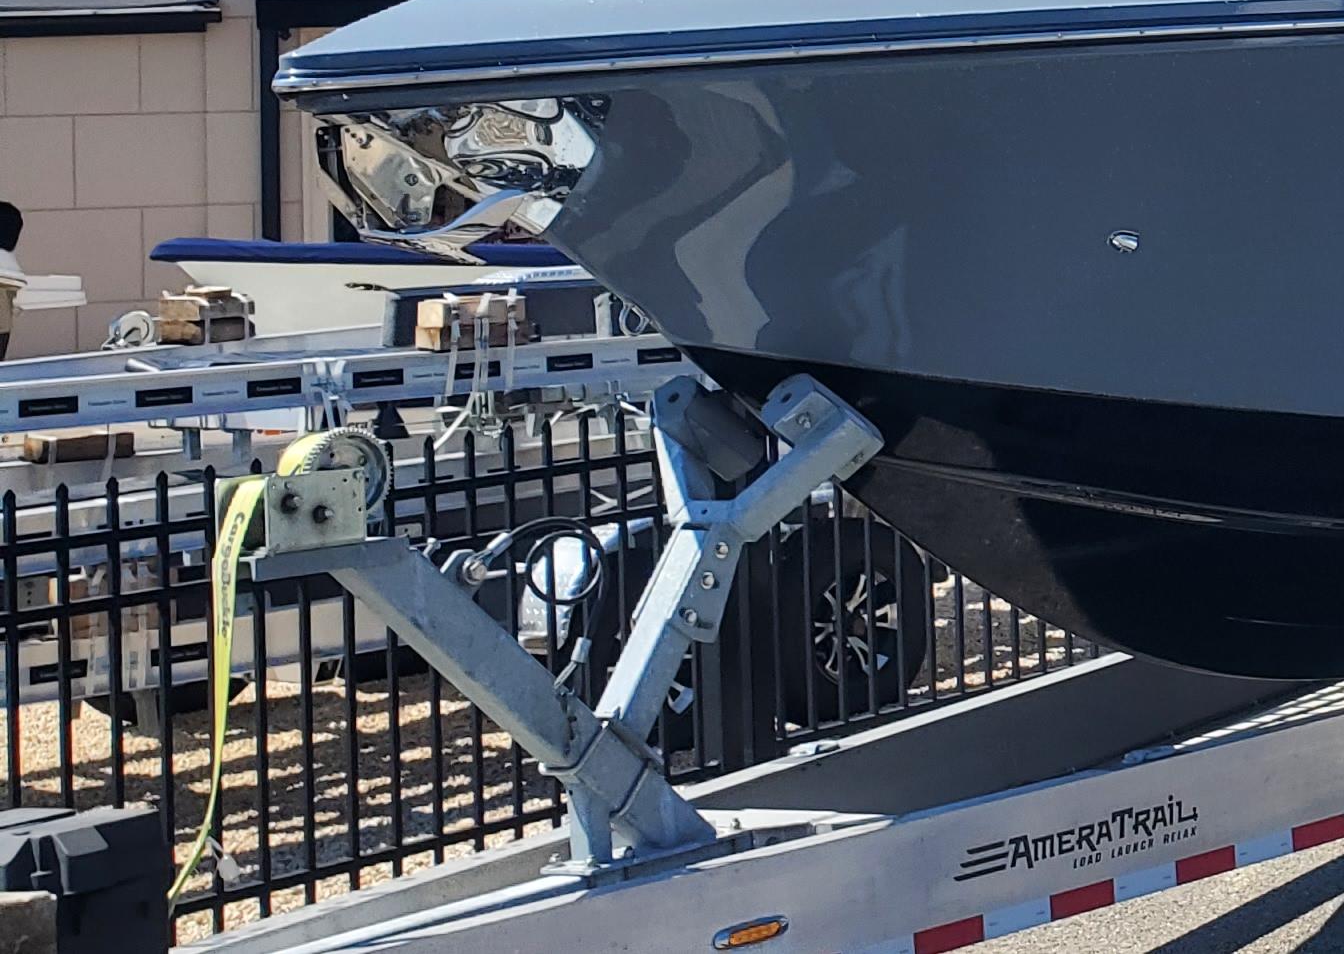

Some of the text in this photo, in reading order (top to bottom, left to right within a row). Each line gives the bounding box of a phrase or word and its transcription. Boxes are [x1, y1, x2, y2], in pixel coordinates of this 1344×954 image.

[1073, 827, 1198, 870] LOAD LAUNCH RELAX
